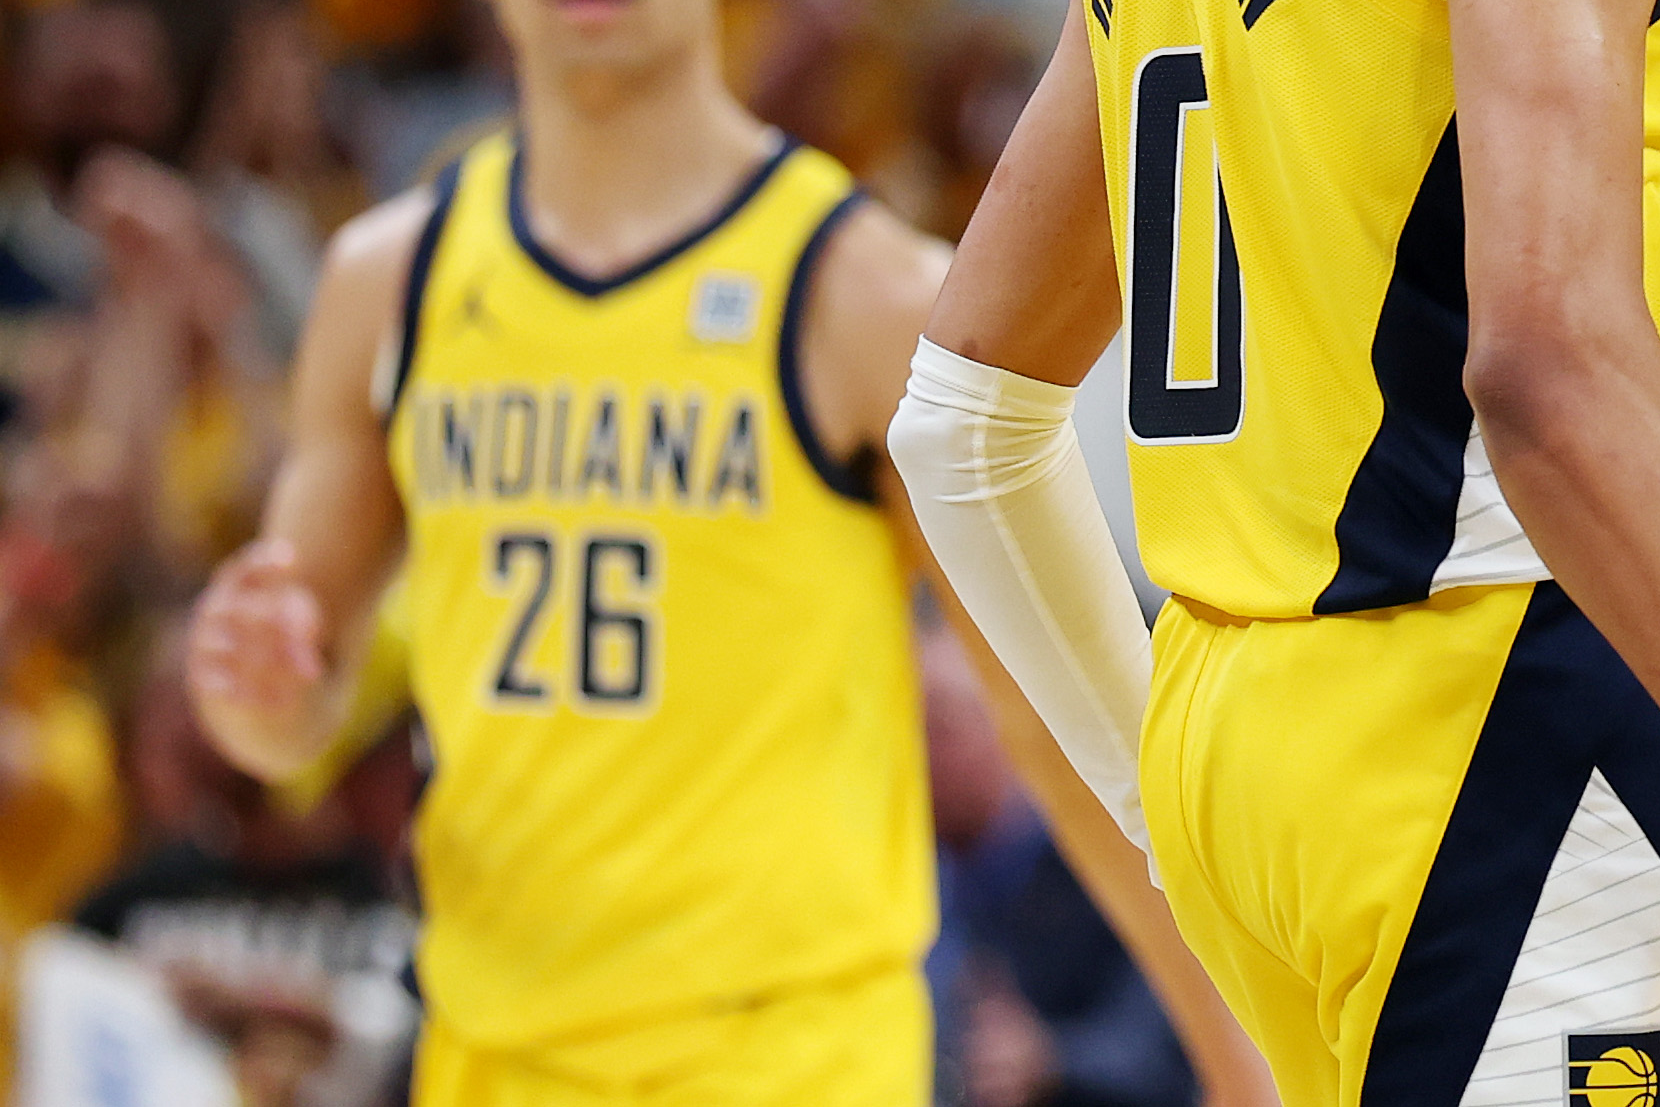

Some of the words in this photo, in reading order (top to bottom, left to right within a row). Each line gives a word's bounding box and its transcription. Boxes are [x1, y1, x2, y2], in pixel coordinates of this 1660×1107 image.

[1122, 45, 1247, 446] 0
[414, 385, 768, 517] INDIANA
[484, 523, 664, 715] 26
